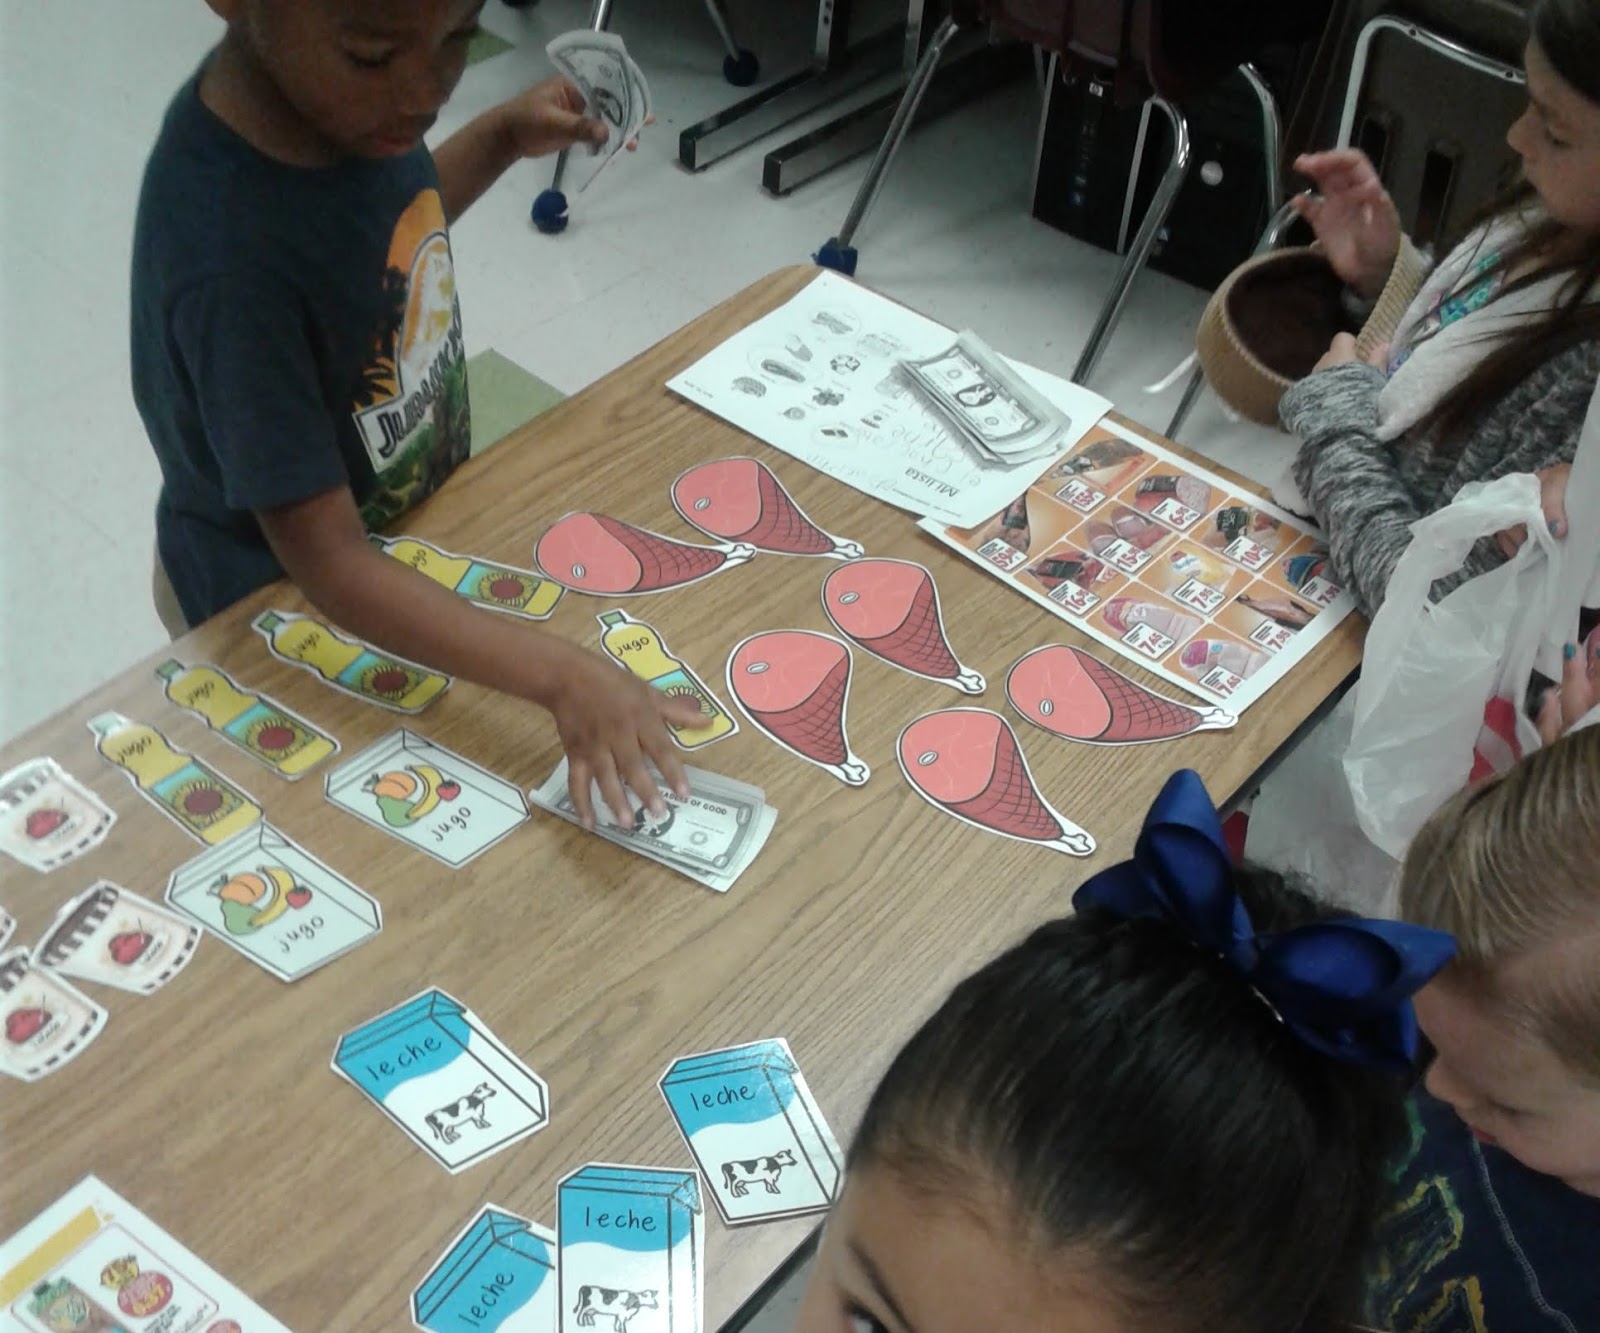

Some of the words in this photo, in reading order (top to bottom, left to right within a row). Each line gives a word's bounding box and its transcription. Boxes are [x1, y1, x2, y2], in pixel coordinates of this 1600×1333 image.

[616, 636, 650, 656] jugo
[117, 735, 152, 765] jugo
[433, 807, 471, 841] jugo
[703, 803, 727, 815] GOOD
[277, 912, 326, 953] jugo
[366, 1031, 442, 1082] leche
[690, 1082, 757, 1111] leche
[584, 1206, 657, 1232] leche
[458, 1268, 515, 1329] leche
